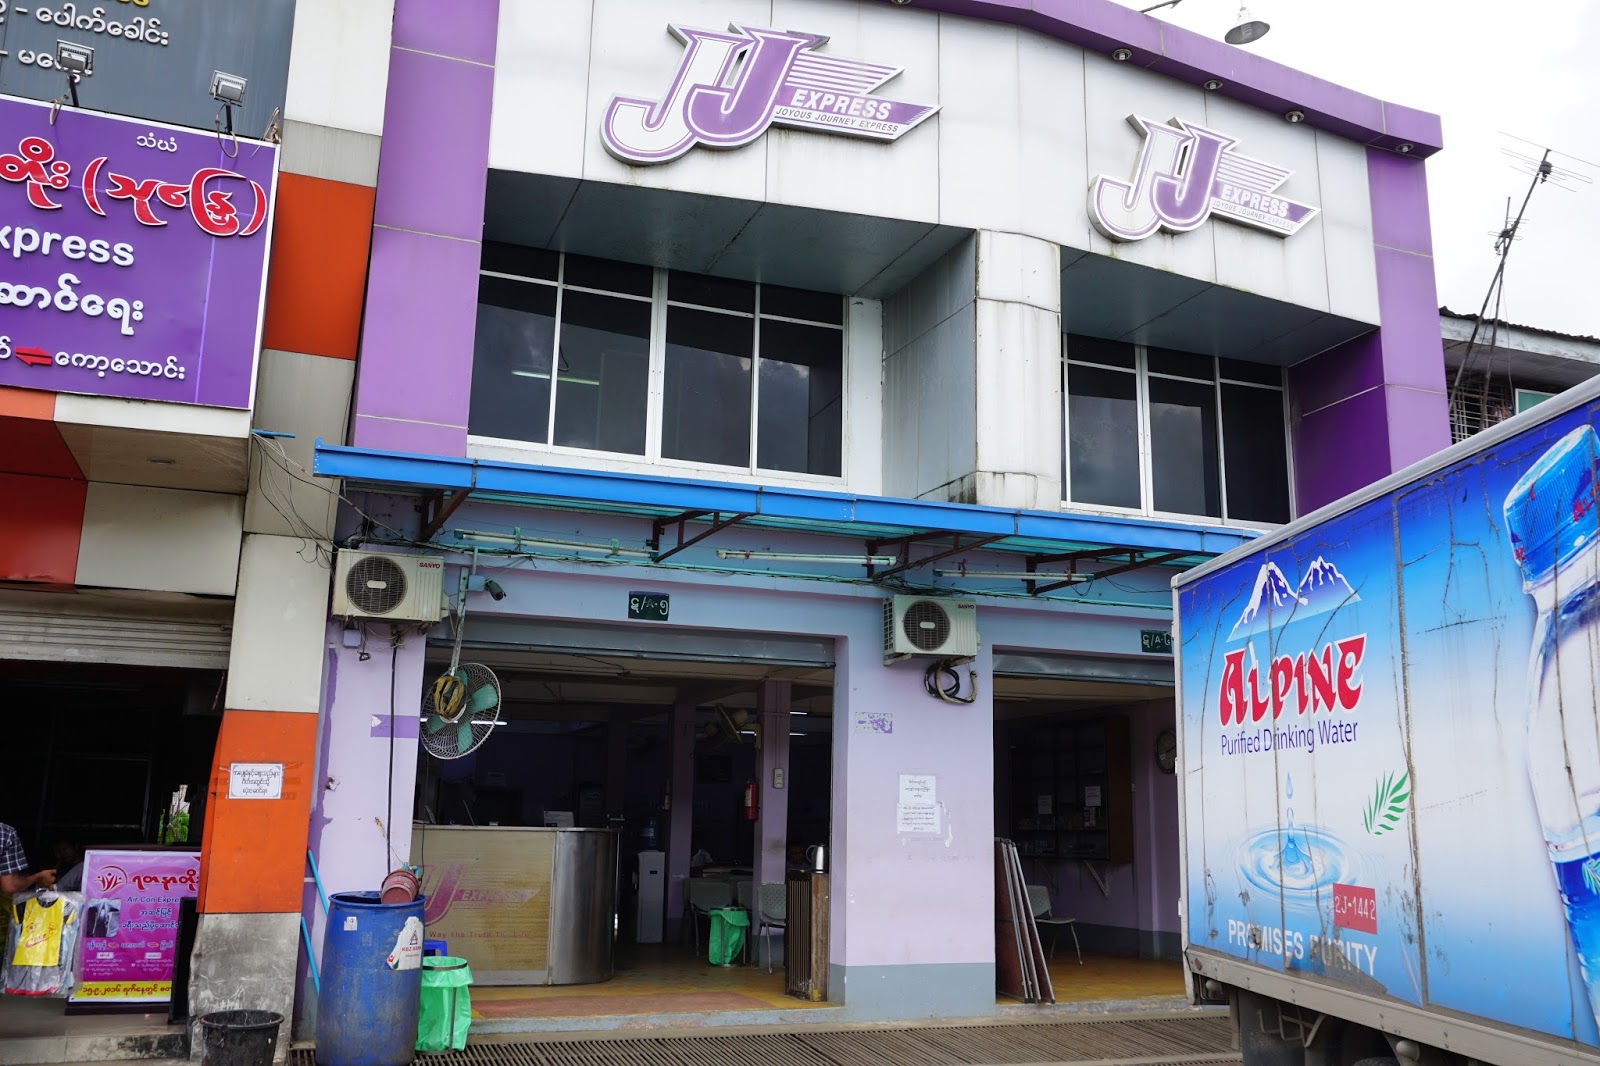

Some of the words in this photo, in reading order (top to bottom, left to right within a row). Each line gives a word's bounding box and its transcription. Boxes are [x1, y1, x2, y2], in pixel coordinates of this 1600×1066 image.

[36, 3, 169, 46] ပေါက်ခေါင်း
[776, 107, 812, 119] JOYOUS
[815, 113, 857, 126] JOURNEY
[859, 121, 899, 133] EXPRESS
[790, 89, 892, 120] EXPRESS
[1213, 200, 1237, 212] JOYOUS
[1239, 207, 1266, 221] JOURNEY
[1268, 216, 1294, 230] EXPRESS
[1221, 184, 1289, 218] EXPRESS
[1219, 633, 1367, 728] ALPINE
[1221, 729, 1260, 756] Purified
[1263, 724, 1315, 753] Drinking
[1318, 719, 1358, 745] Water
[1334, 895, 1376, 920] 2J-1442
[1228, 919, 1304, 960] PROMISES
[1310, 934, 1378, 977] PURITY
